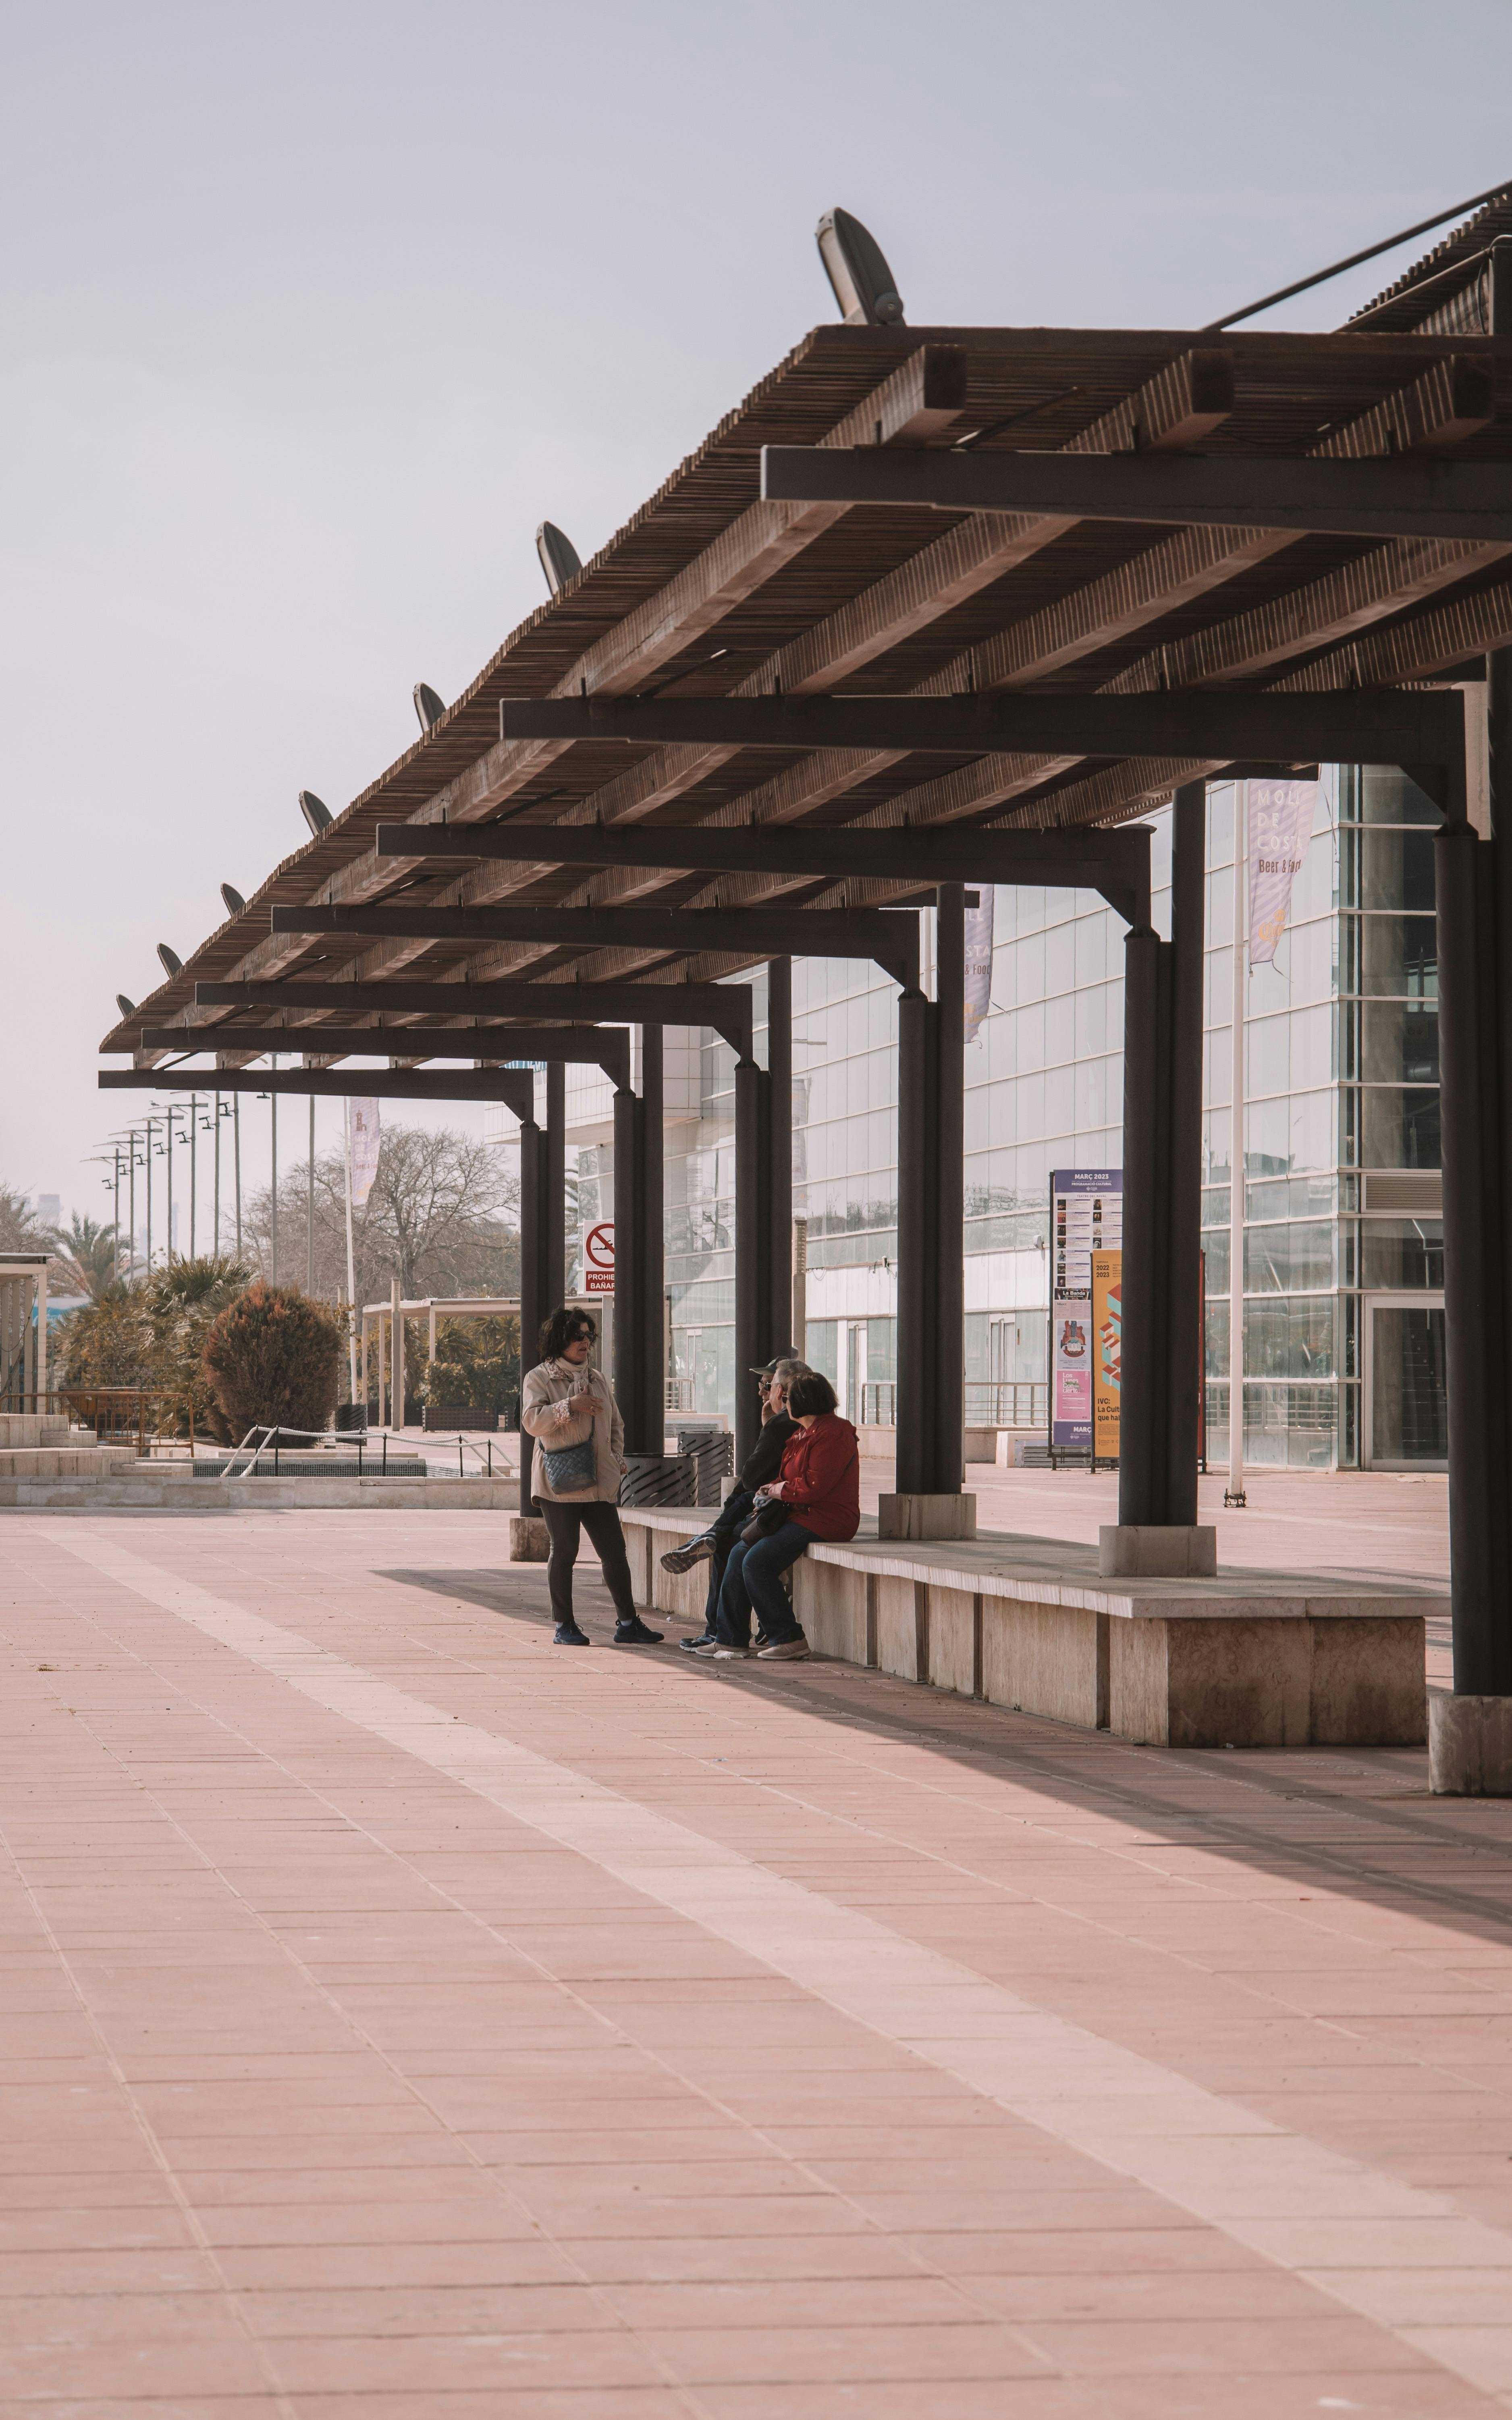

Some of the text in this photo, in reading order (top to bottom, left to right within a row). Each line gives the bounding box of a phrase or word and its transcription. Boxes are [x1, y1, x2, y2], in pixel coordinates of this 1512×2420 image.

[1257, 812, 1279, 828] DE
[1257, 835, 1302, 851] COSTA
[1259, 859, 1279, 873] Beer
[1282, 859, 1286, 873] &
[968, 909, 984, 921] LL
[966, 945, 991, 958] STA
[965, 964, 970, 975] &
